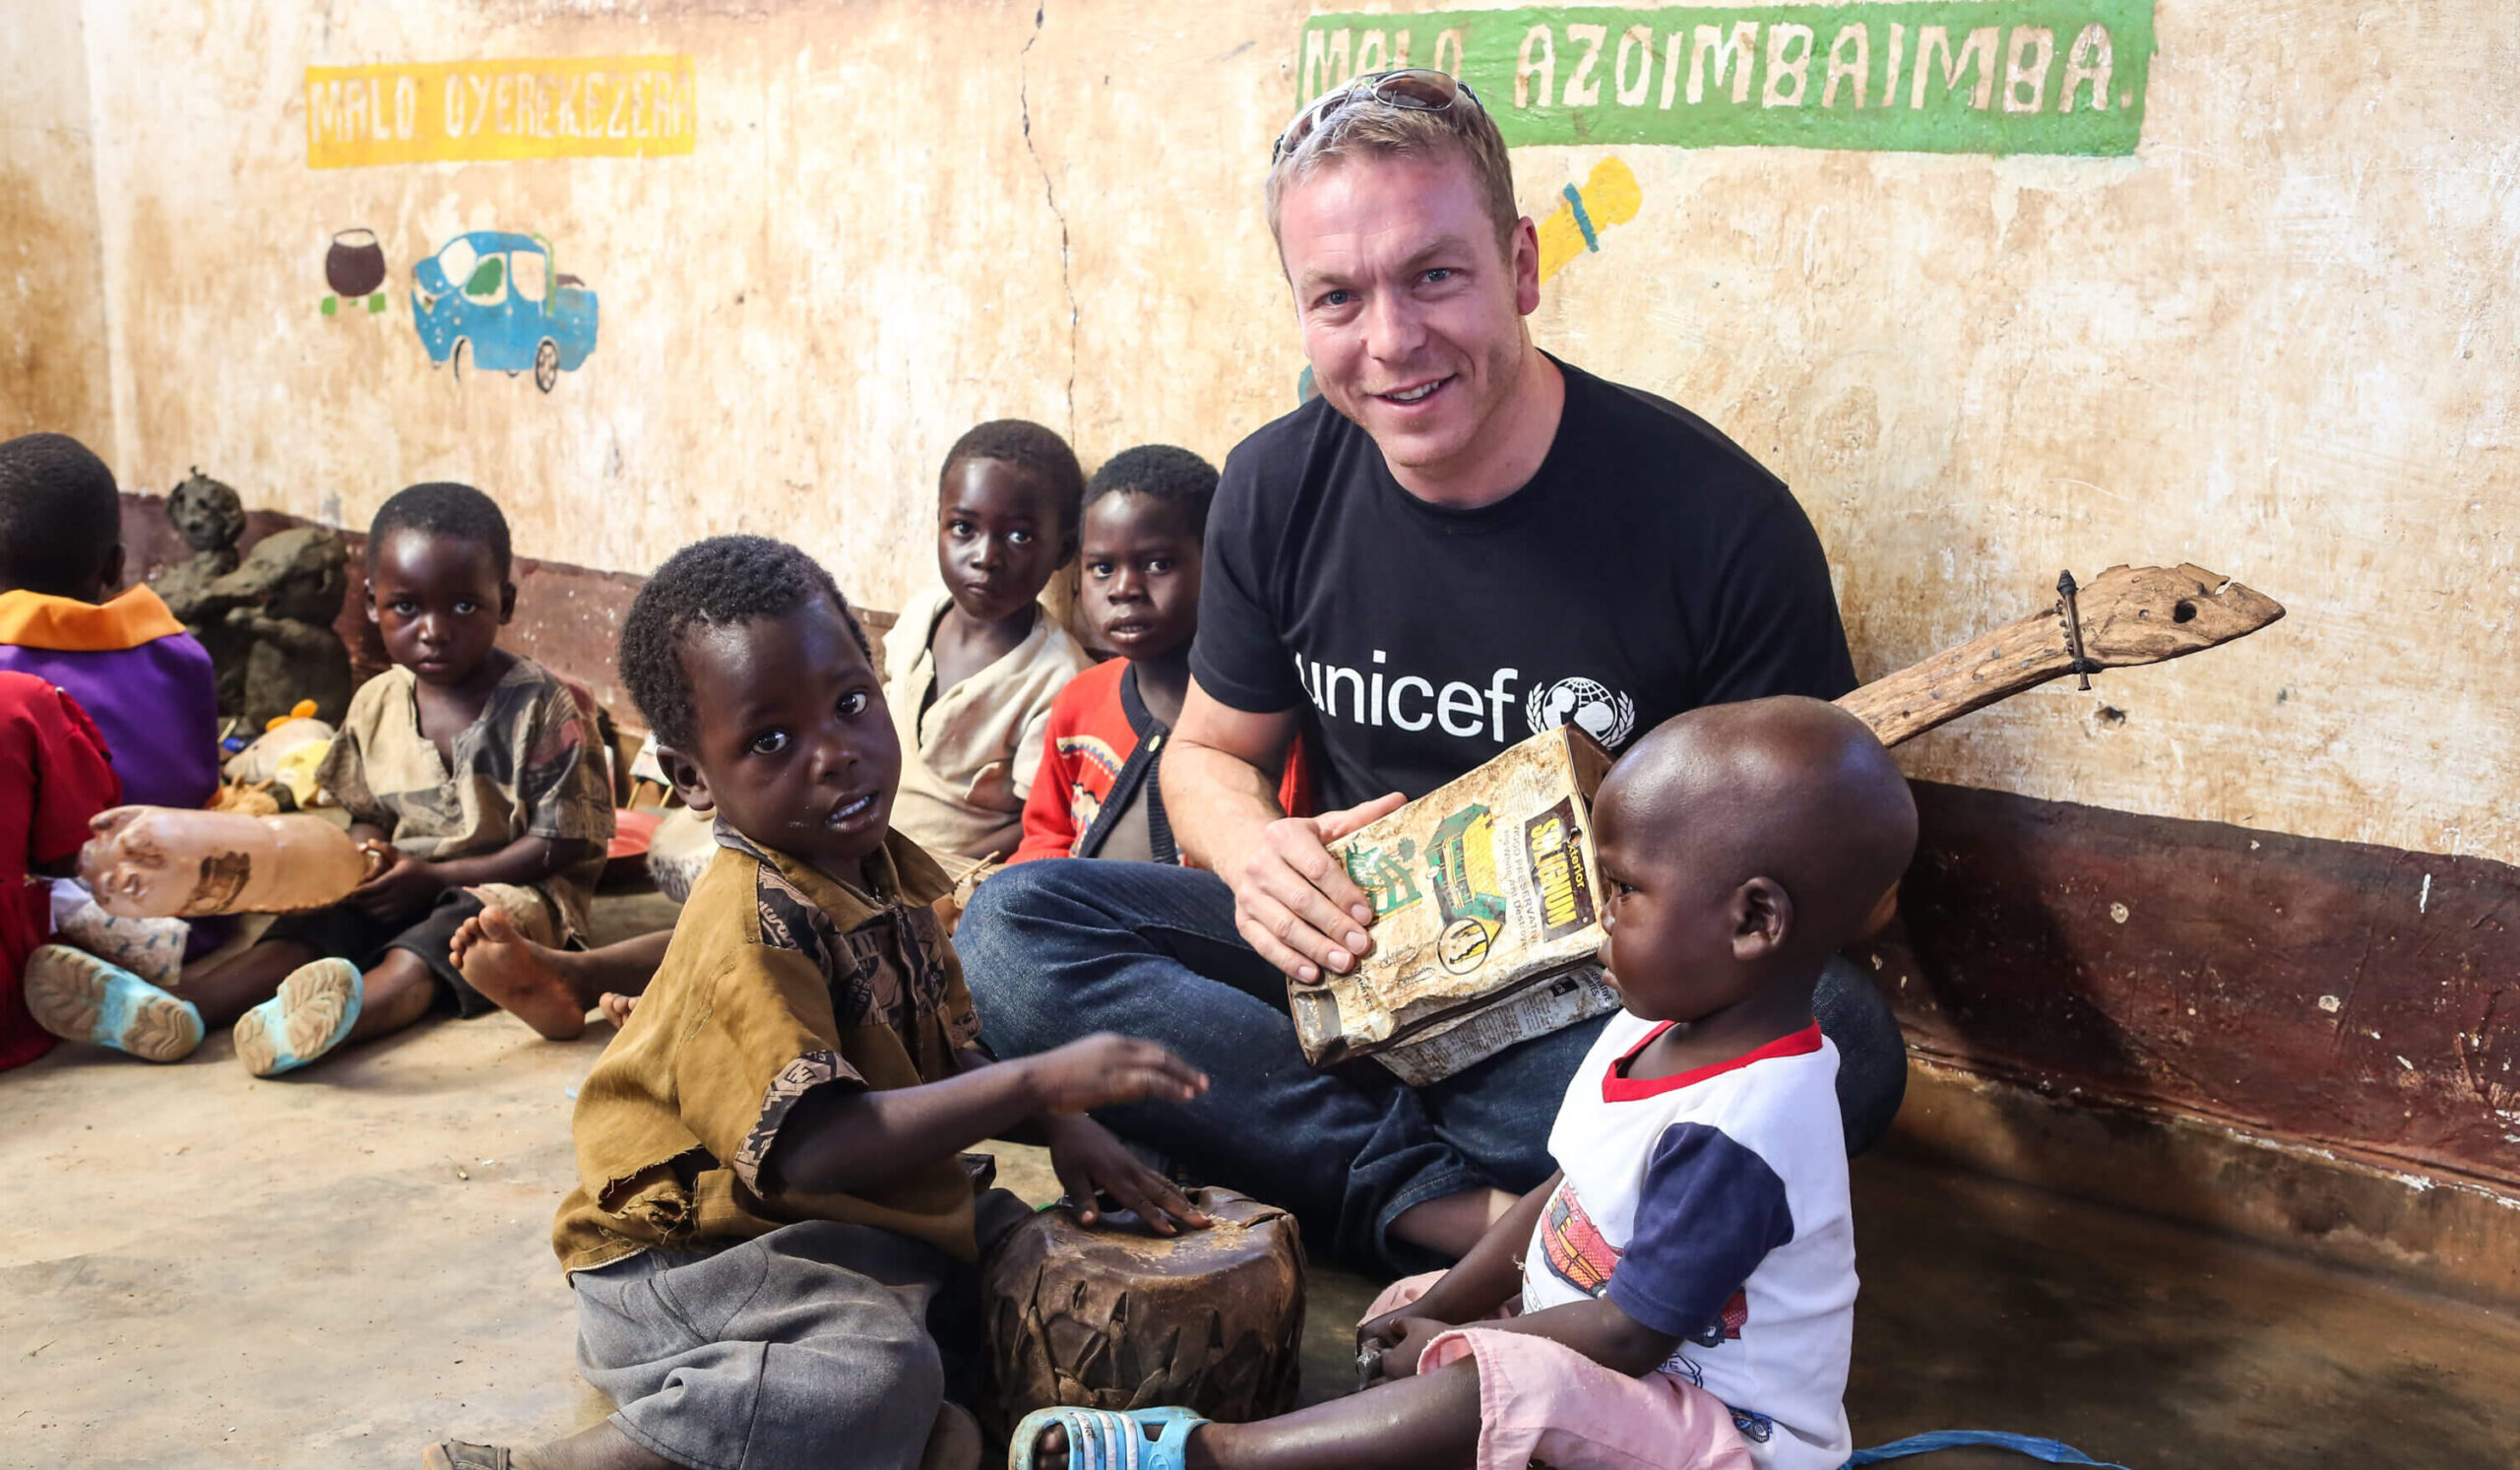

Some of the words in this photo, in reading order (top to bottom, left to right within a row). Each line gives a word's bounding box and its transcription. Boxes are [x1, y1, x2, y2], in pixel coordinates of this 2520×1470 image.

[310, 76, 415, 143] MALO
[444, 71, 693, 139] OYEREKEZERA
[1514, 21, 2133, 112] AZOIMBAIMBA.
[1295, 650, 1518, 742] unicef
[1515, 859, 1538, 947] PRESERVATIVE
[1531, 817, 1577, 929] SOLIGNUM
[1567, 841, 1586, 888] xterior
